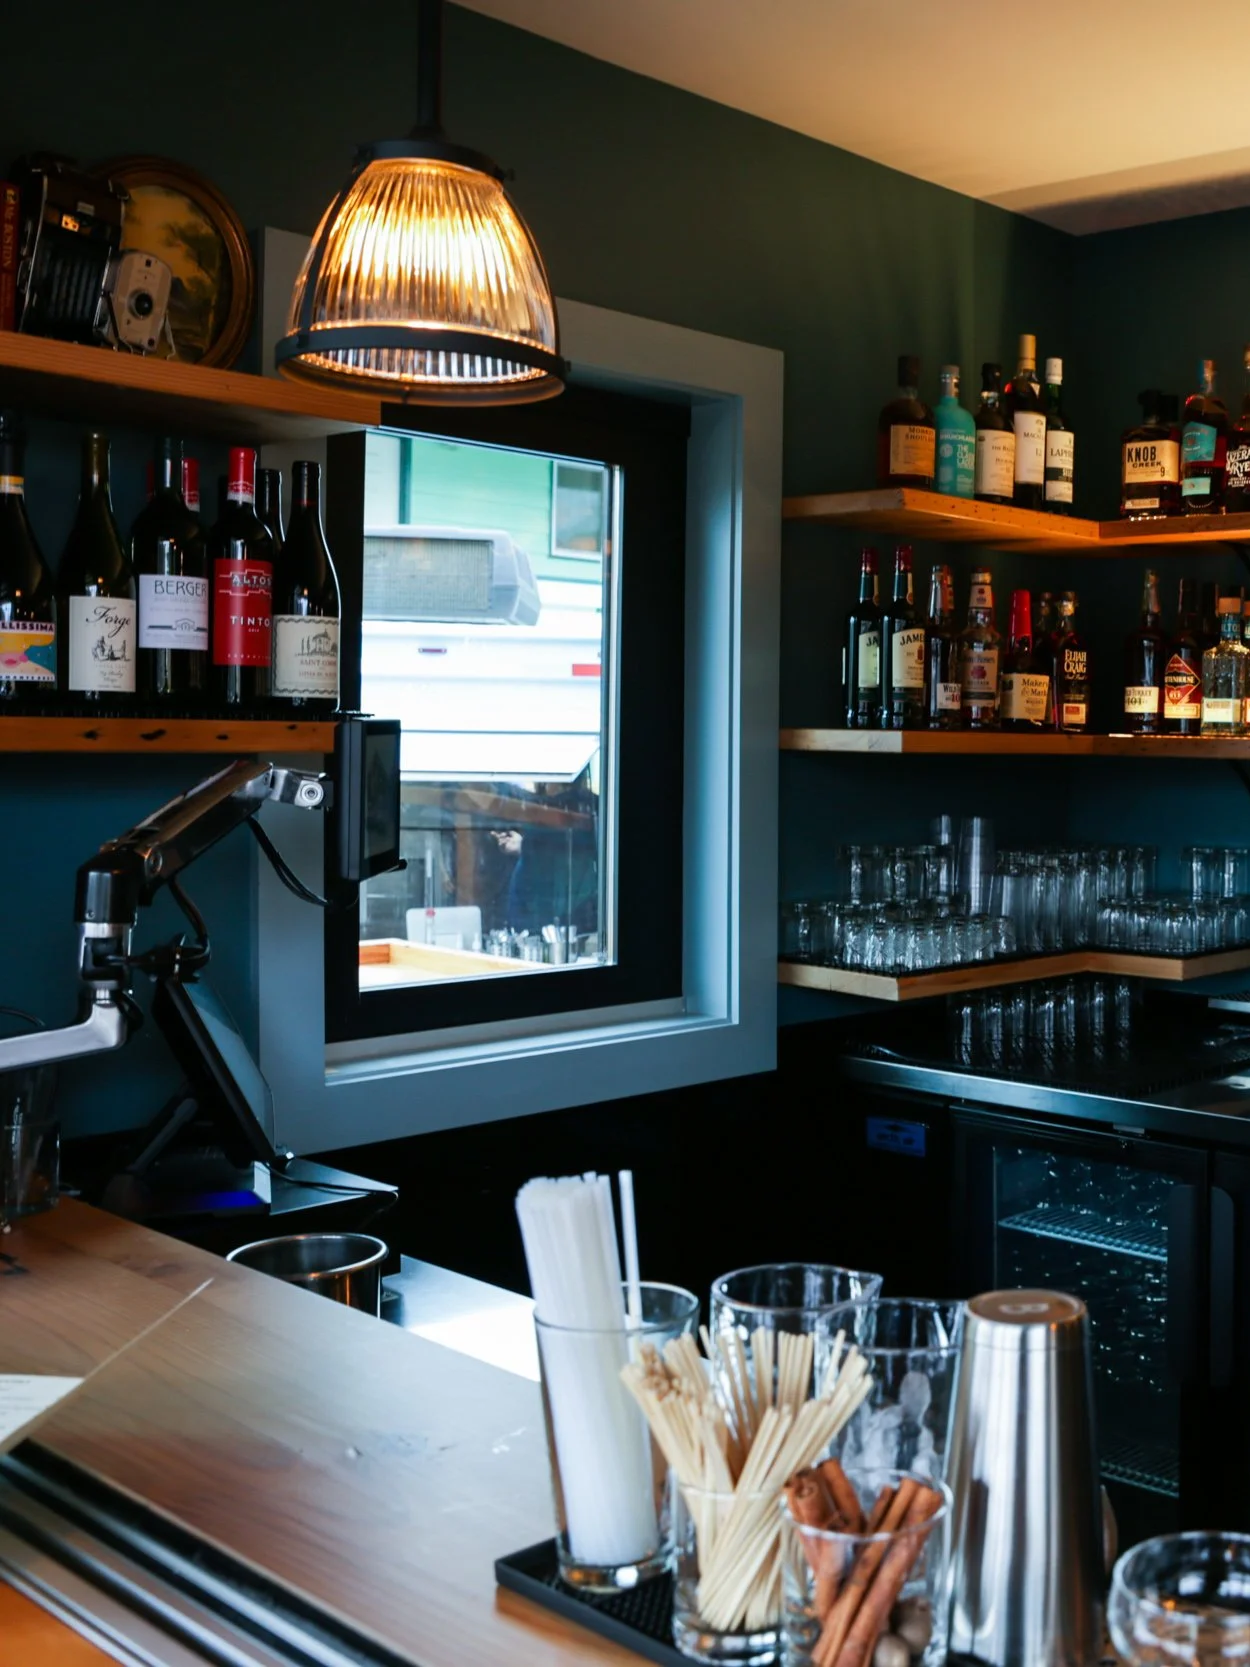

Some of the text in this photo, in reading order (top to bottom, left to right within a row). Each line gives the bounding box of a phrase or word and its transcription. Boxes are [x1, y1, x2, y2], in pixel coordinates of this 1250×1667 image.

[1127, 446, 1157, 463] KNOB
[1132, 461, 1162, 469] CREEK
[154, 579, 207, 598] BERGER
[85, 605, 132, 639] Forge
[230, 615, 270, 627] TINTO
[1065, 649, 1087, 662] ELIJAH
[1064, 661, 1087, 674] CRAIG
